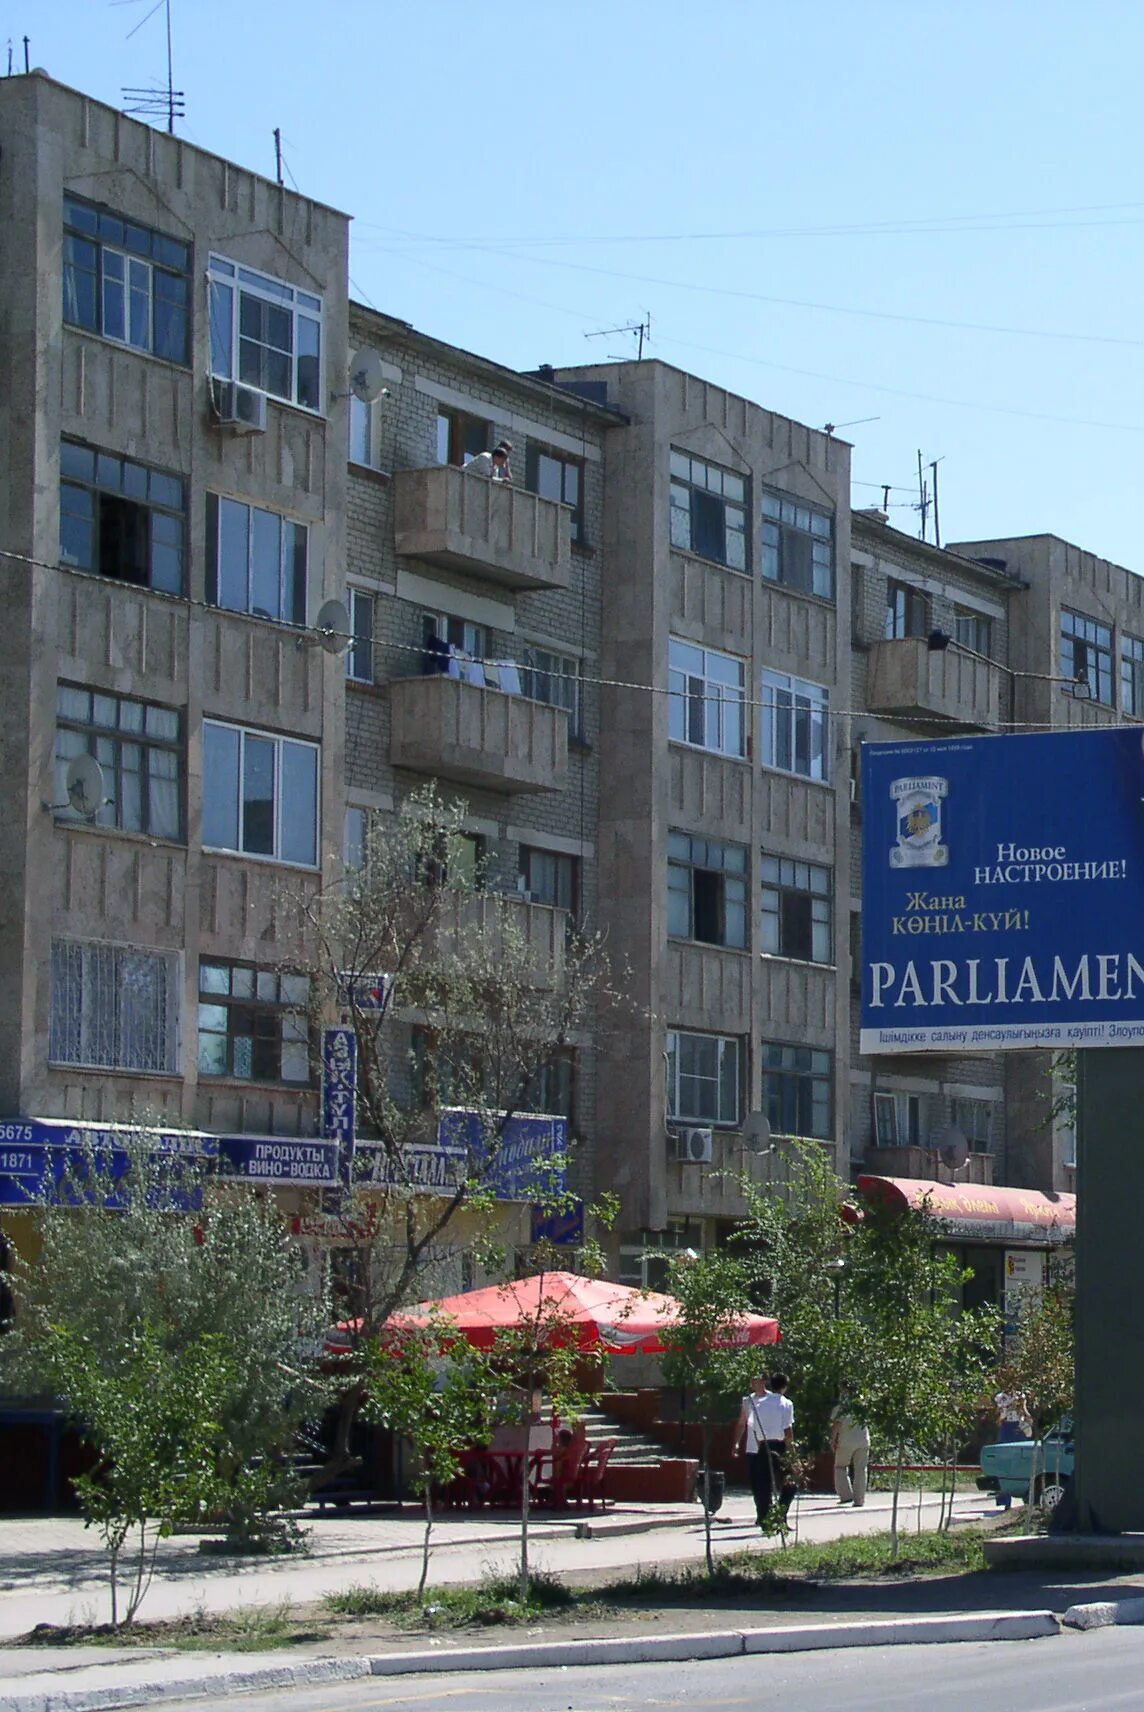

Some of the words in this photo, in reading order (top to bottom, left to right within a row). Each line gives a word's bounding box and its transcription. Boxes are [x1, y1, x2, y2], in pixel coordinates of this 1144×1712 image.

[894, 780, 945, 794] PARLIAMENT
[996, 843, 1067, 863] Новое
[974, 860, 1127, 885] НАСТРОЕНИЕ!
[1, 1153, 32, 1169] 1871
[255, 1144, 325, 1163] ПРОДУКТЫ
[249, 1160, 331, 1179] ВИНО-ВОДКА
